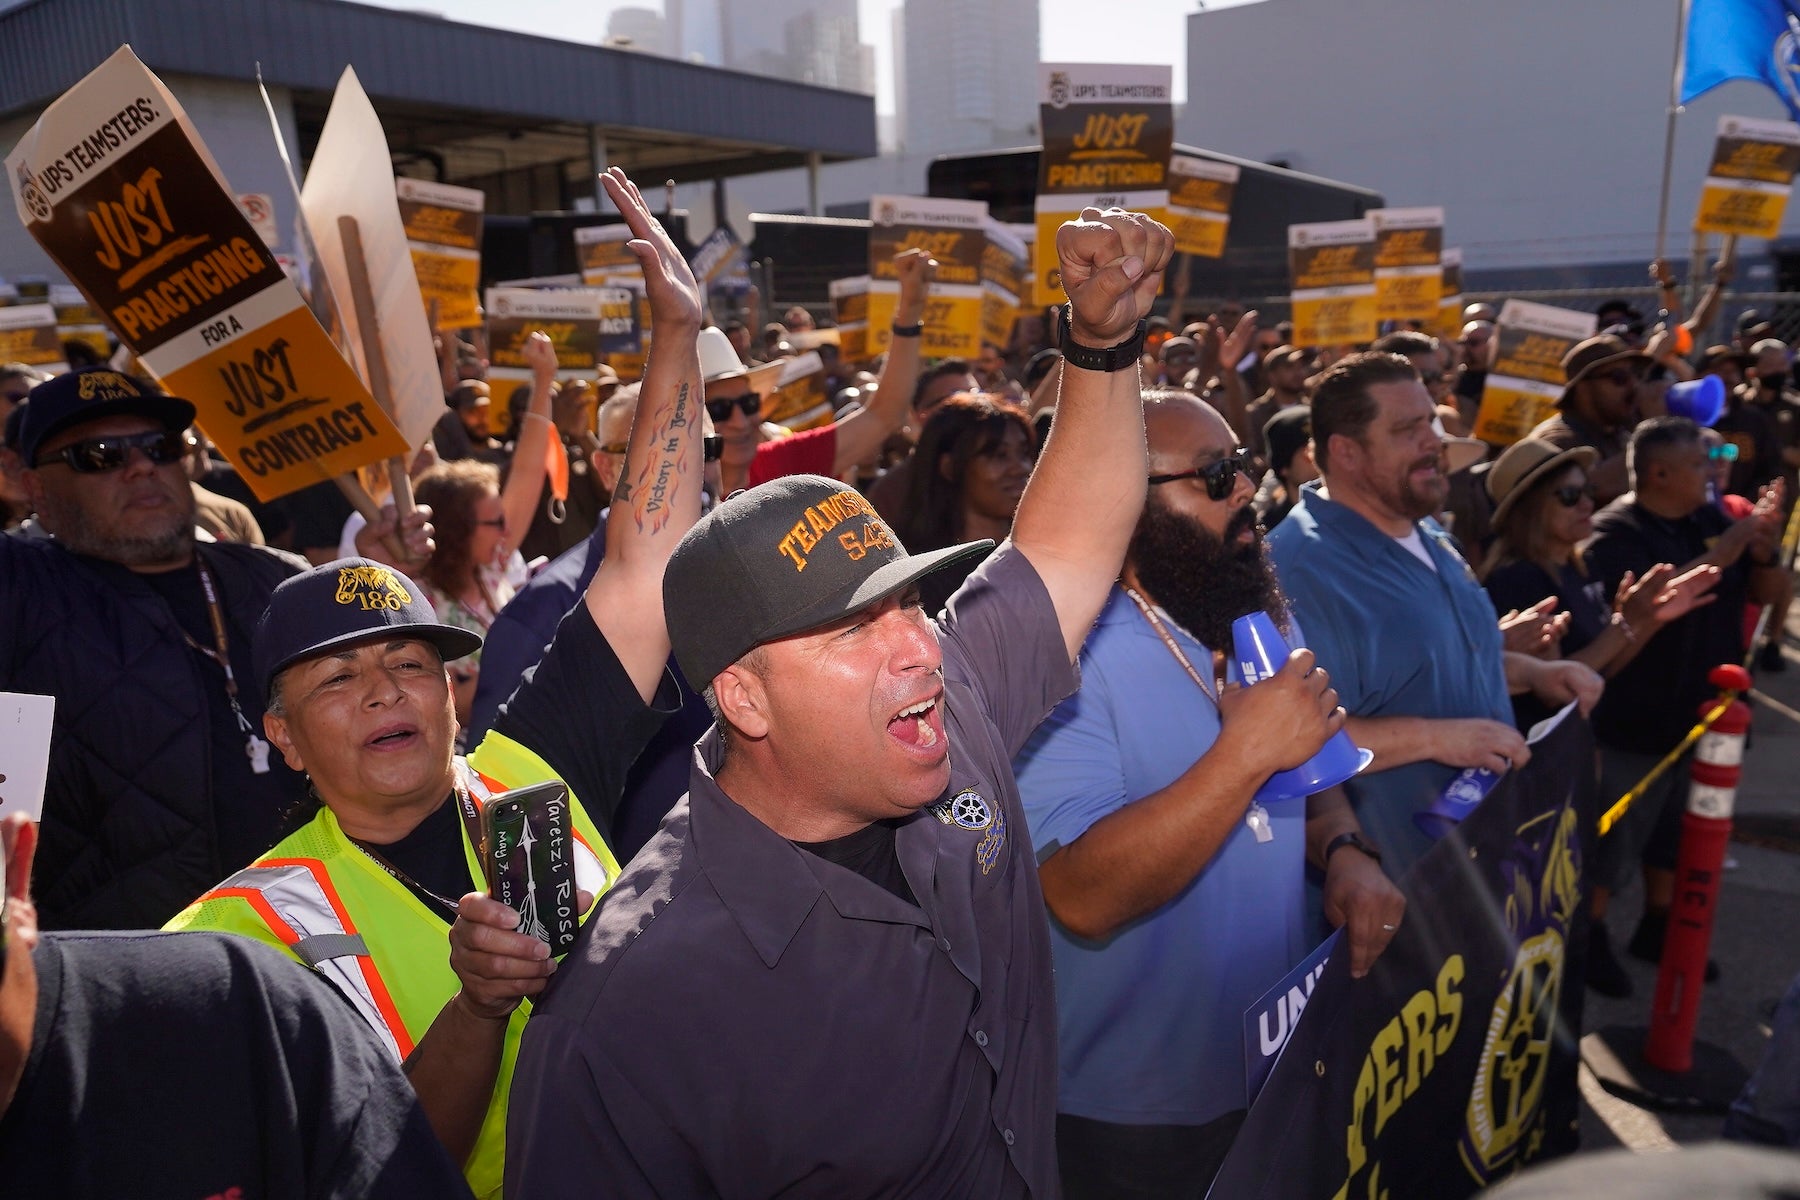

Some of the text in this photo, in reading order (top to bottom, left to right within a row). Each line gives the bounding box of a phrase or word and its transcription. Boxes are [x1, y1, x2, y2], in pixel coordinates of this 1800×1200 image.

[37, 97, 160, 194] UPS TEAMSTERS:
[1072, 112, 1150, 149] JUST
[1047, 161, 1164, 188] PRACTICING
[87, 166, 175, 270] JUST
[112, 236, 266, 341] PRACTICING
[200, 314, 243, 347] FOR A
[218, 336, 298, 417] JUST
[238, 402, 378, 477] CONTRACT
[646, 382, 689, 515] Victory in Jesus
[355, 591, 402, 612] 186
[494, 831, 507, 858] May
[501, 881, 513, 907] 202
[546, 791, 575, 945] Yaretzi Rose
